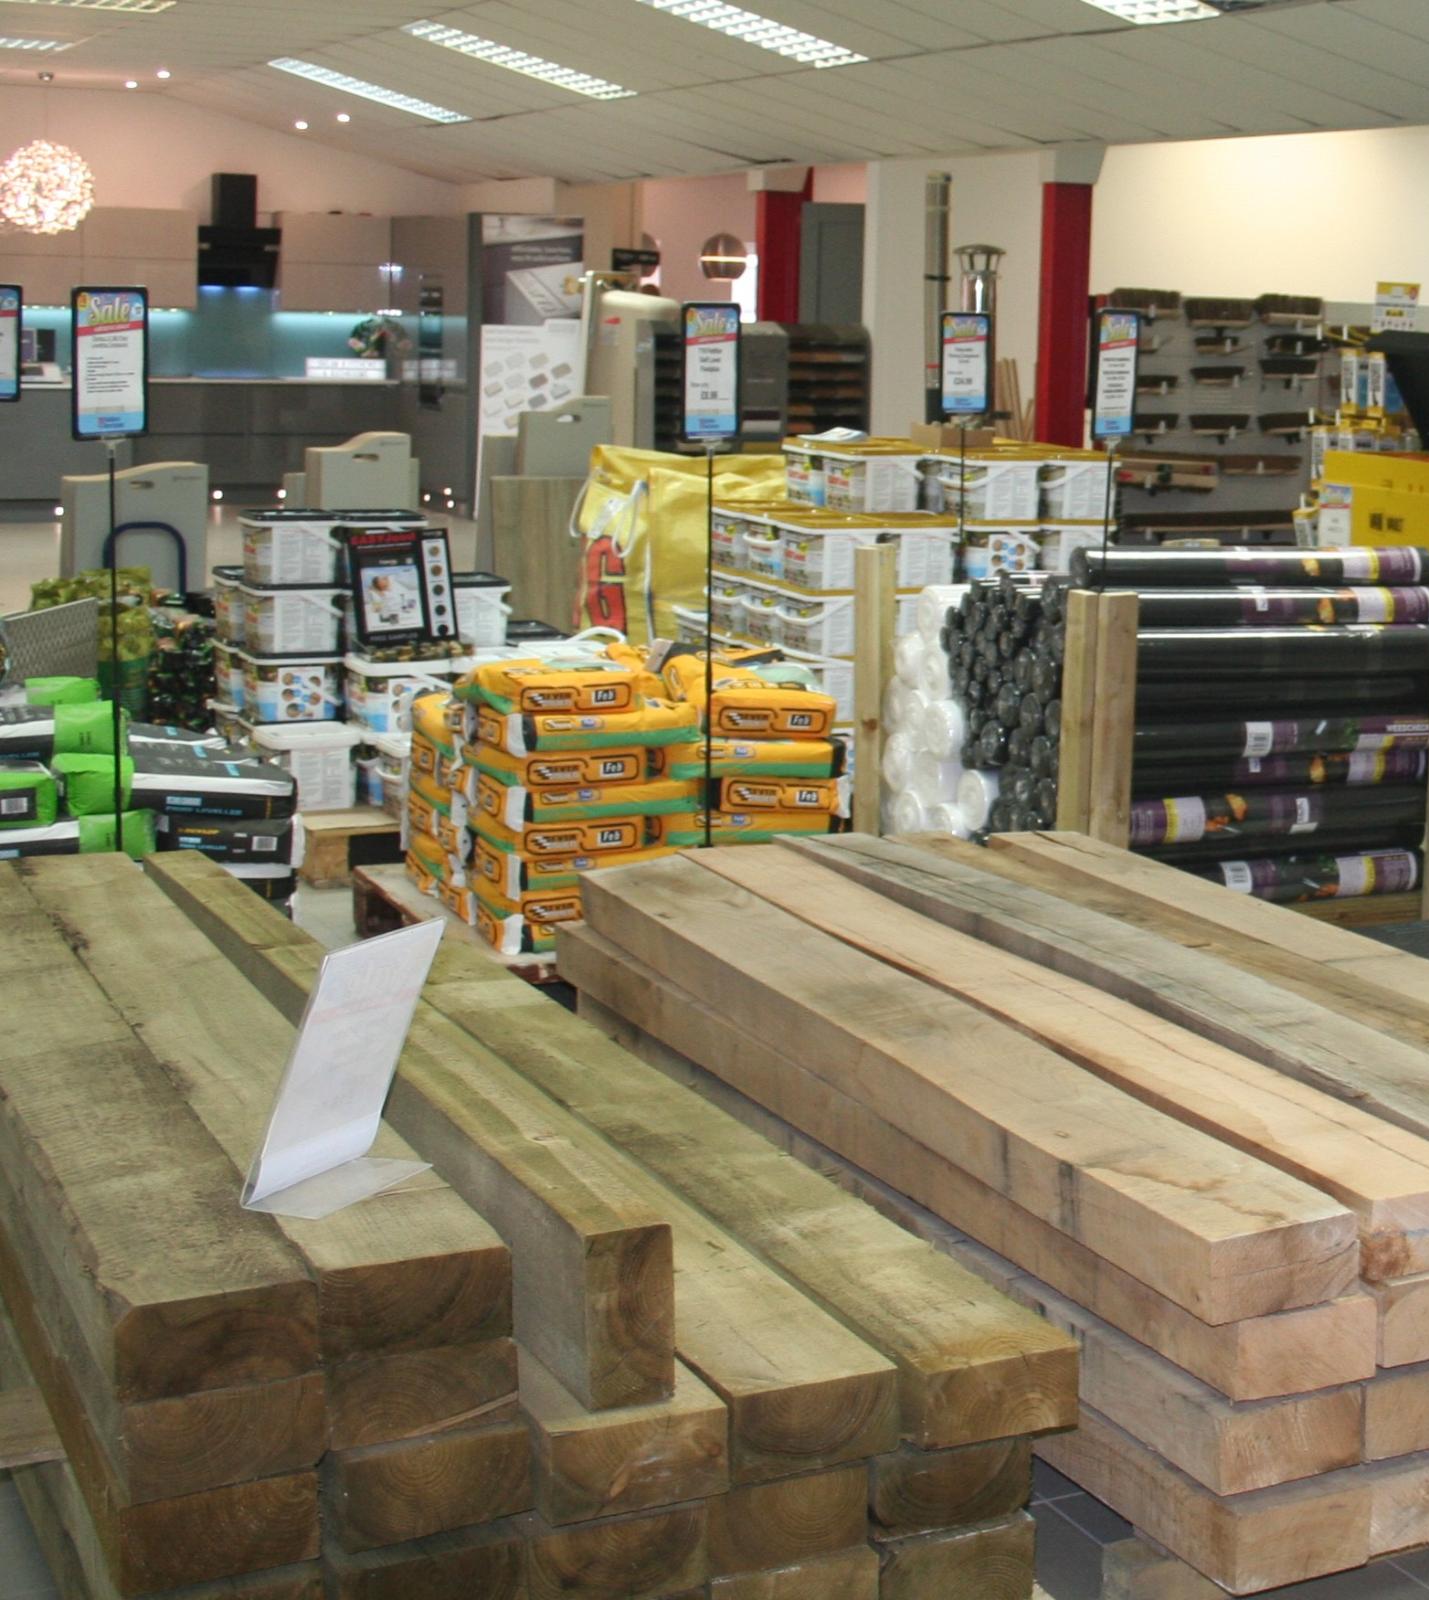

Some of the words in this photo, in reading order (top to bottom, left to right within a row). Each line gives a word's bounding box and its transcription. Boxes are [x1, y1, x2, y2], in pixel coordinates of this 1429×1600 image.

[89, 296, 130, 322] Sale
[597, 688, 615, 701] Feb
[793, 715, 809, 726] Feb
[605, 761, 623, 774] Feb
[802, 791, 818, 803] Feb
[603, 830, 621, 843] Feb
